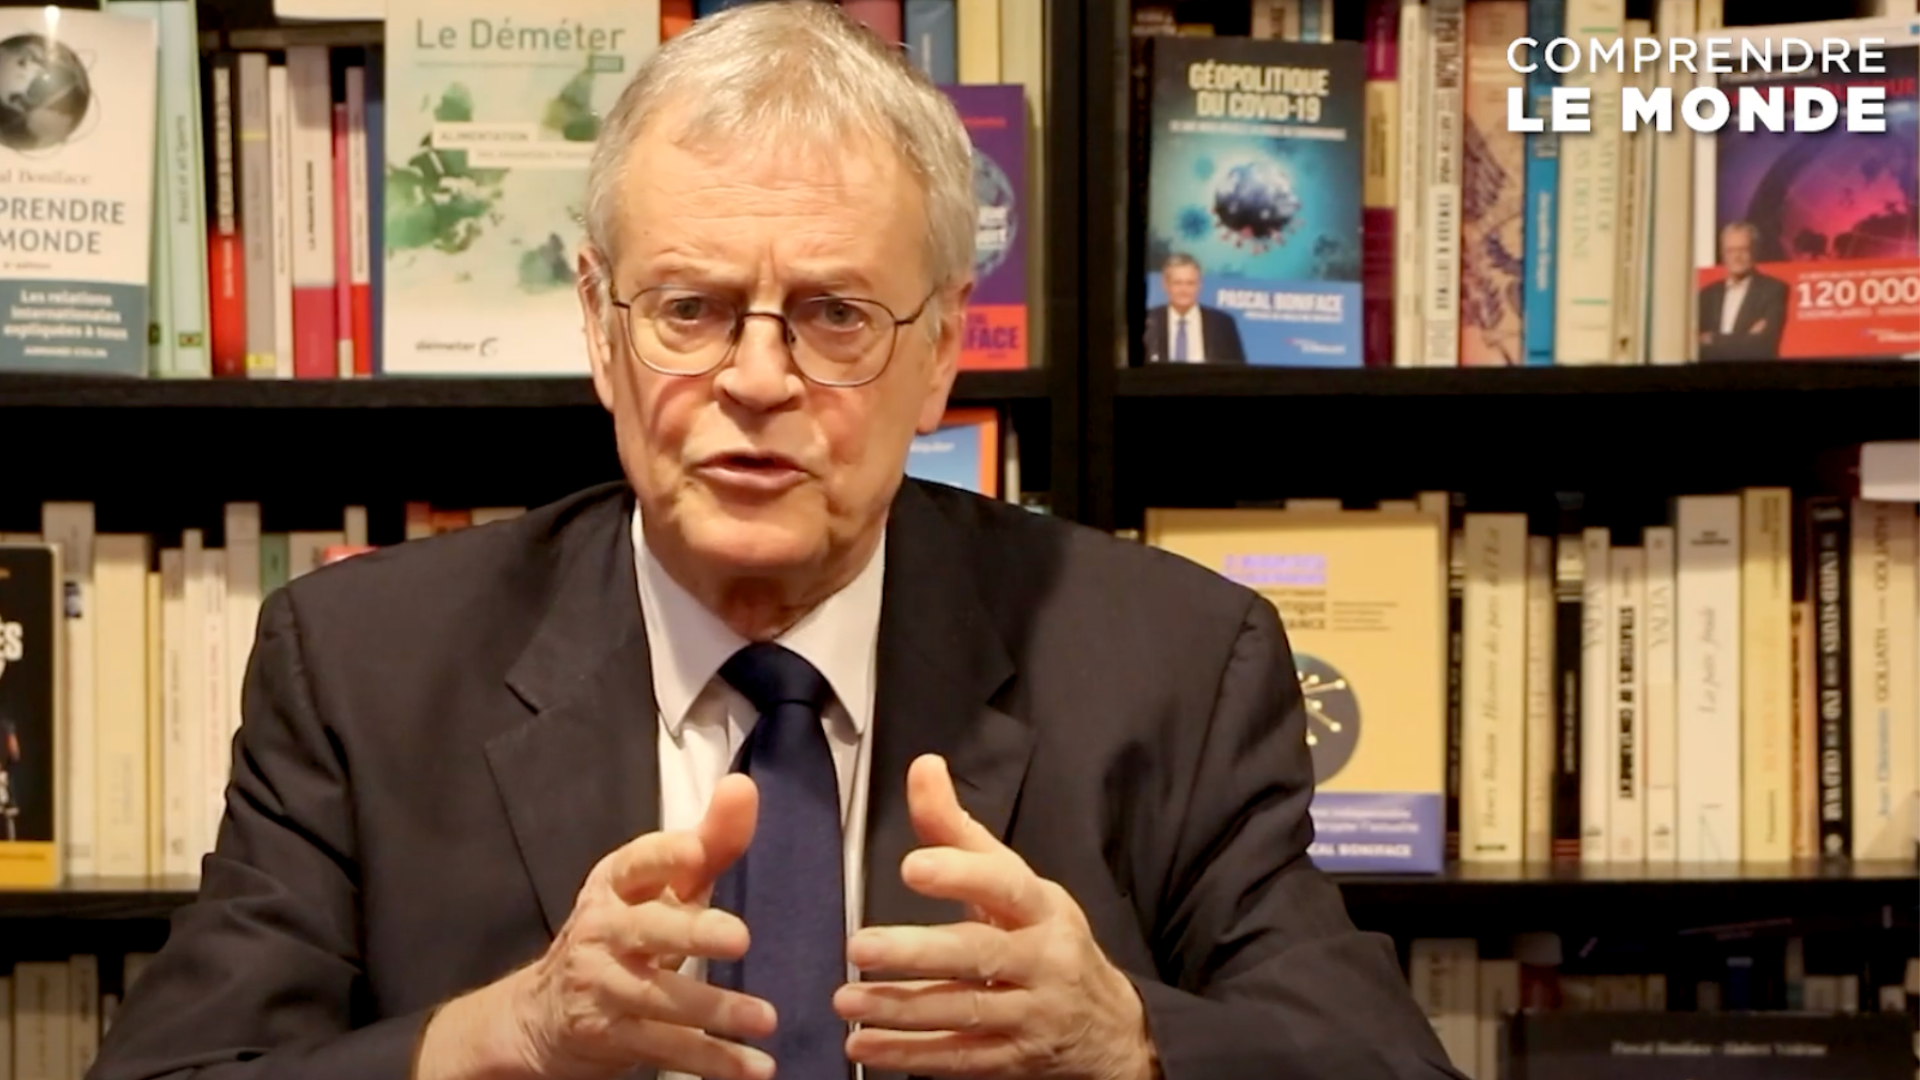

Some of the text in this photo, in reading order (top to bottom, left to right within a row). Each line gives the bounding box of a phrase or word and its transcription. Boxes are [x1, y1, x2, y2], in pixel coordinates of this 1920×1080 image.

[416, 17, 626, 51] Le Déméter
[1188, 59, 1330, 97] GÉOPOLITIQUE
[1196, 91, 1322, 123] DU COVID-19
[18, 169, 91, 186] Boniface
[0, 197, 126, 226] PRENDRE
[0, 228, 102, 255] MONDE
[20, 289, 45, 304] Les
[1217, 288, 1344, 312] PASCAL BONIFACE
[1797, 276, 1920, 308] 120 000
[10, 304, 122, 325] internationales
[0, 614, 23, 662] S
